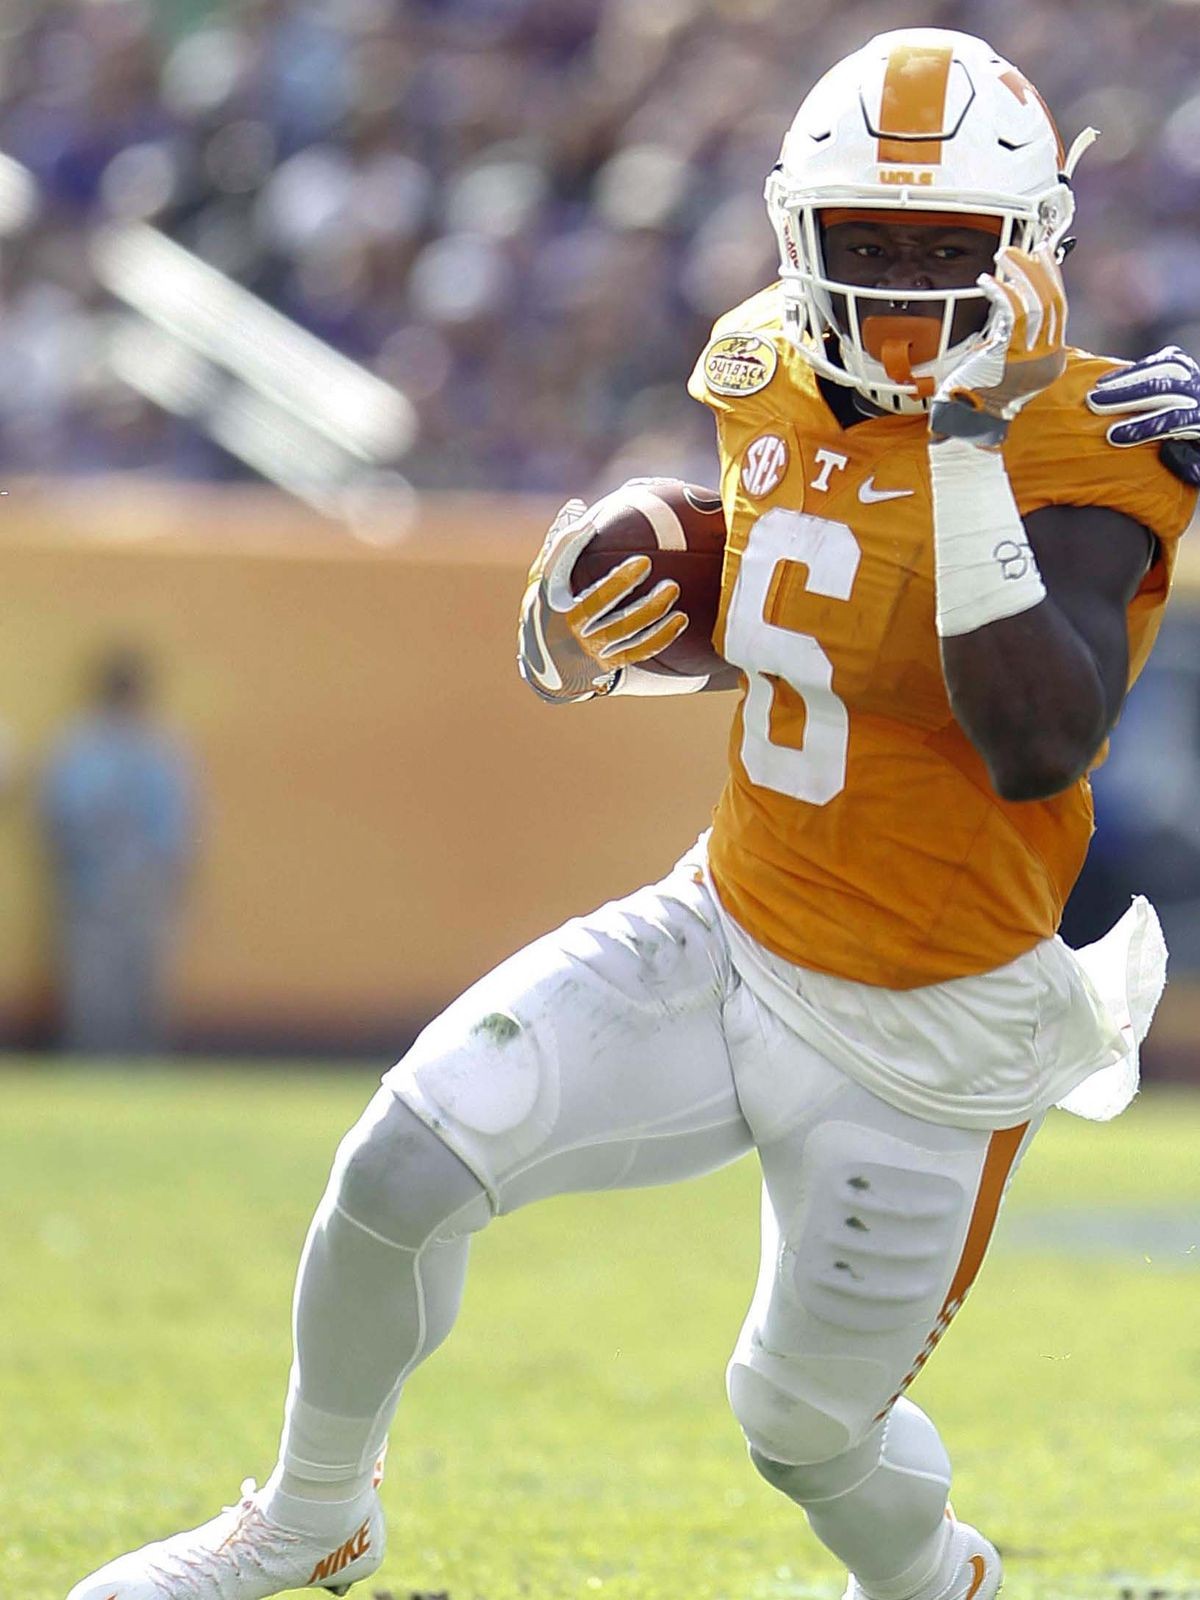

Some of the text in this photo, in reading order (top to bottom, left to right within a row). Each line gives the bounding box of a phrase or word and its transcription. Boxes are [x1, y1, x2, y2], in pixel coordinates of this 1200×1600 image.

[708, 360, 767, 382] OUTBACK
[741, 435, 785, 496] SEC
[809, 448, 848, 492] T
[724, 507, 862, 807] 6
[306, 1516, 371, 1586] NIKE
